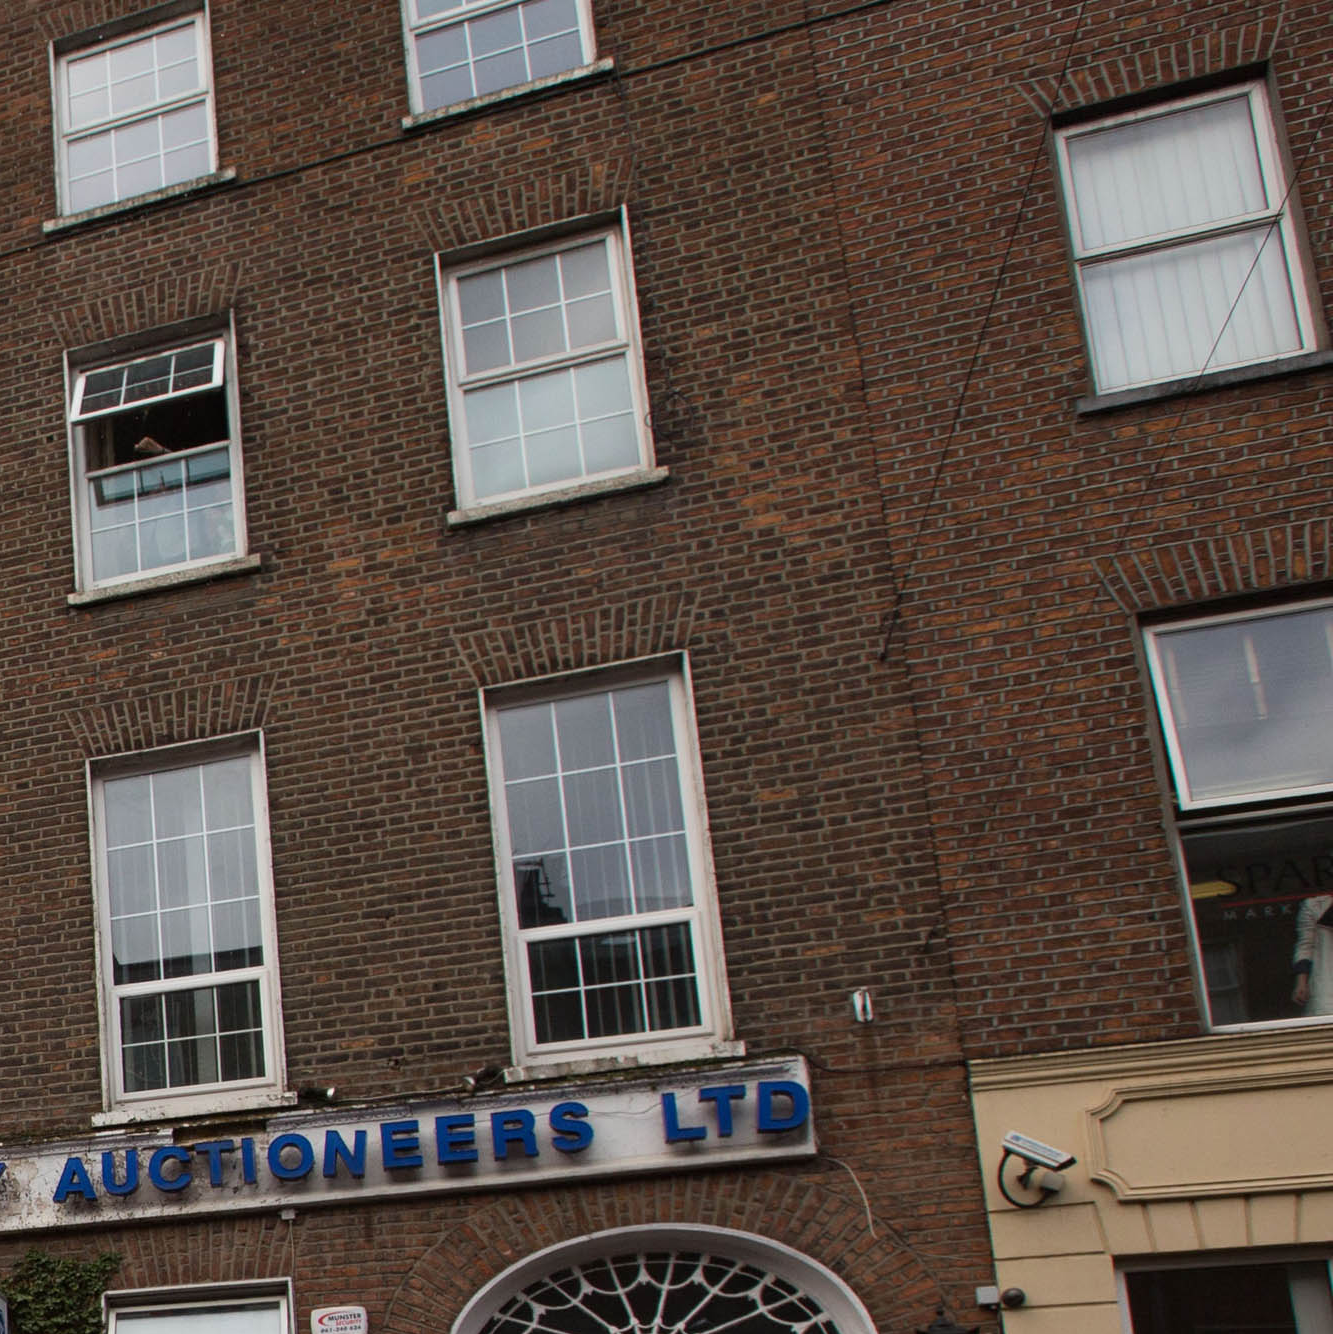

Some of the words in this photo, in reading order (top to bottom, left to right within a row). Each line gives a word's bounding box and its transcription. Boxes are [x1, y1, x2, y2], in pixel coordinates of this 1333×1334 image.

[52, 1100, 595, 1202] AUCTIONEERS
[661, 1080, 810, 1144] LTD
[328, 1313, 361, 1321] MUNSTER
